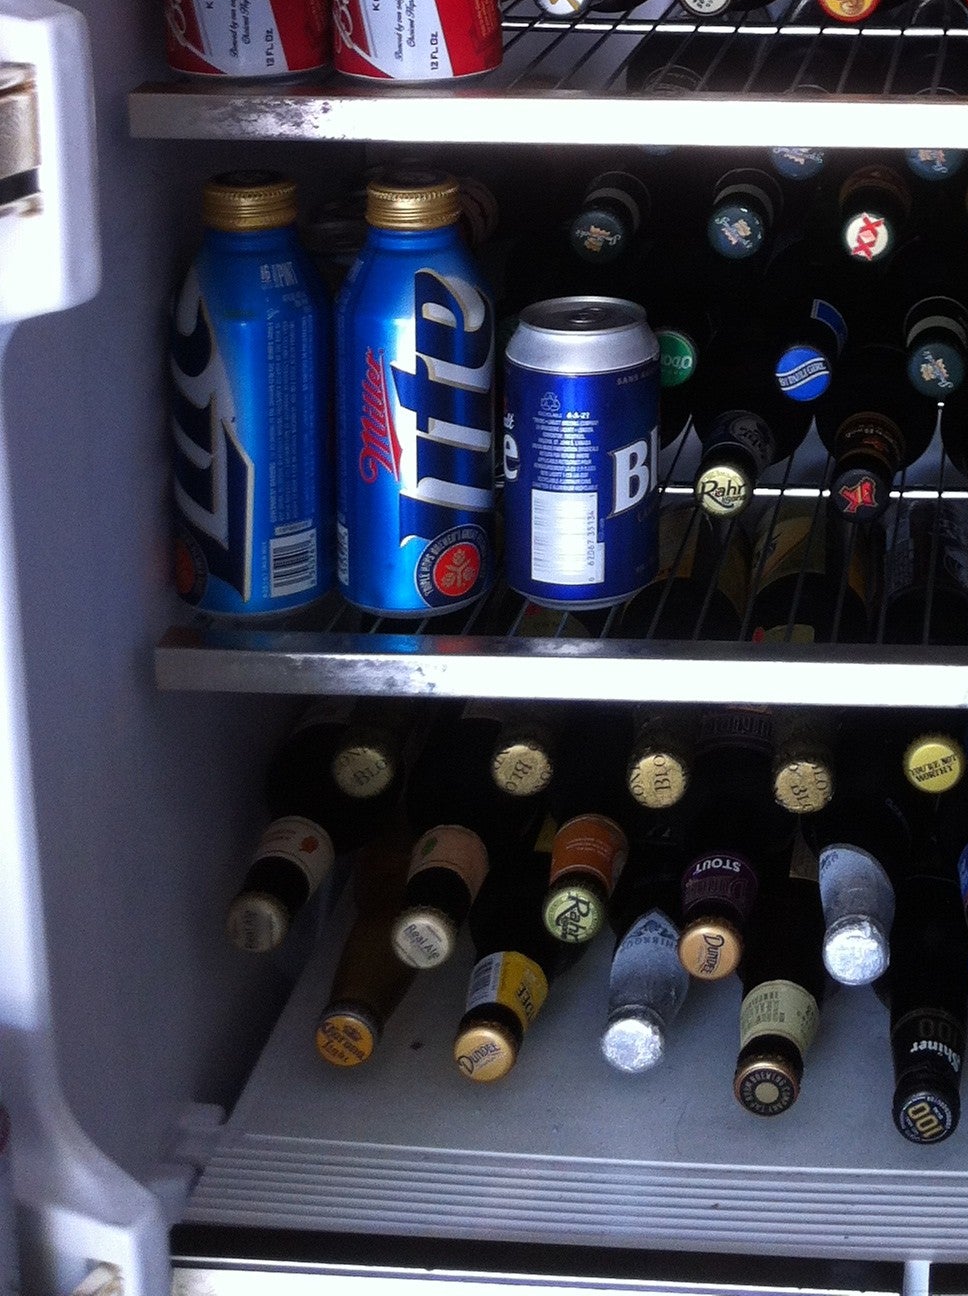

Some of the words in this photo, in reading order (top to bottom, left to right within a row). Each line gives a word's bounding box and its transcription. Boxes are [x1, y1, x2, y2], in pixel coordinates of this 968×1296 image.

[267, 57, 274, 66] 12
[431, 61, 439, 70] 12
[806, 360, 827, 377] GIRL
[358, 346, 403, 486] Miller
[389, 268, 494, 548] Lite
[611, 424, 658, 519] Bl
[700, 478, 745, 508] Rahr
[914, 765, 954, 783] WORTHY
[693, 857, 742, 876] STOUT
[558, 892, 592, 942] Rahr
[405, 922, 424, 945] Real
[422, 941, 442, 962] Ale
[910, 1039, 960, 1074] Shiner
[907, 1102, 944, 1138] 100
